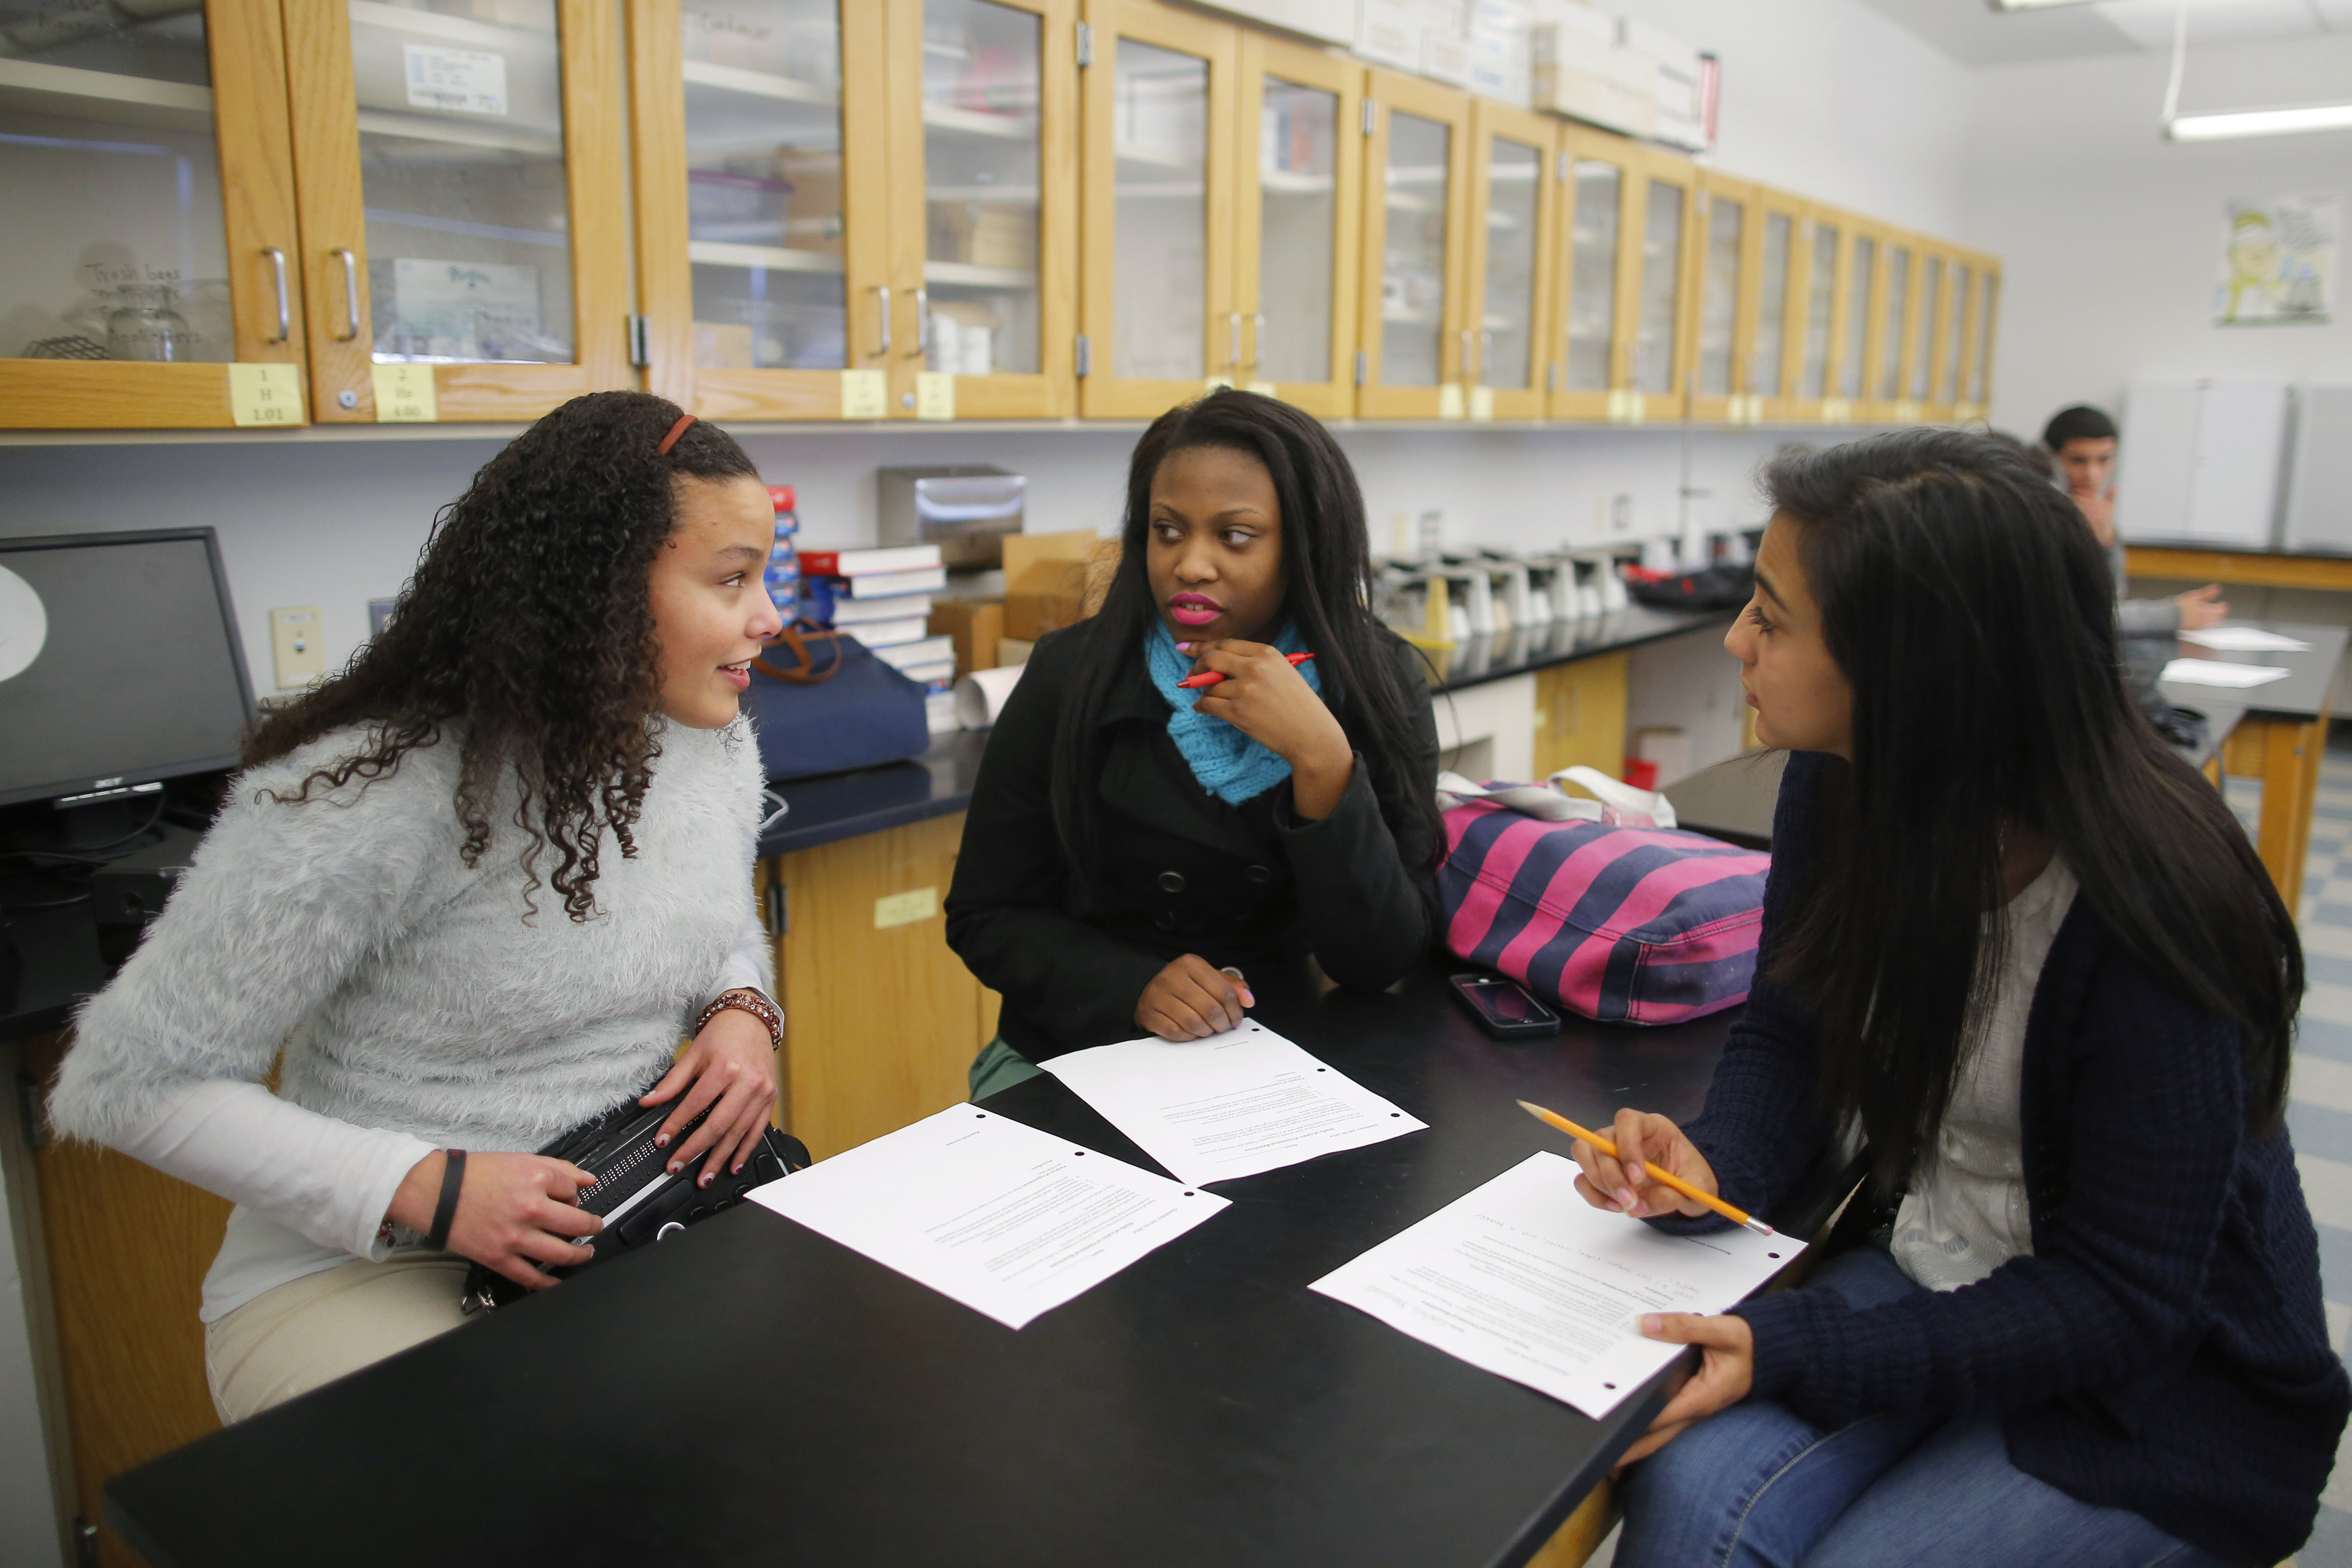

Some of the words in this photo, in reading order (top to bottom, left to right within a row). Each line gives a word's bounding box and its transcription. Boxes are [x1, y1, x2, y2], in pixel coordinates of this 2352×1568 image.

[260, 369, 267, 381] 1
[259, 388, 271, 400] H
[252, 407, 284, 421] 1.01
